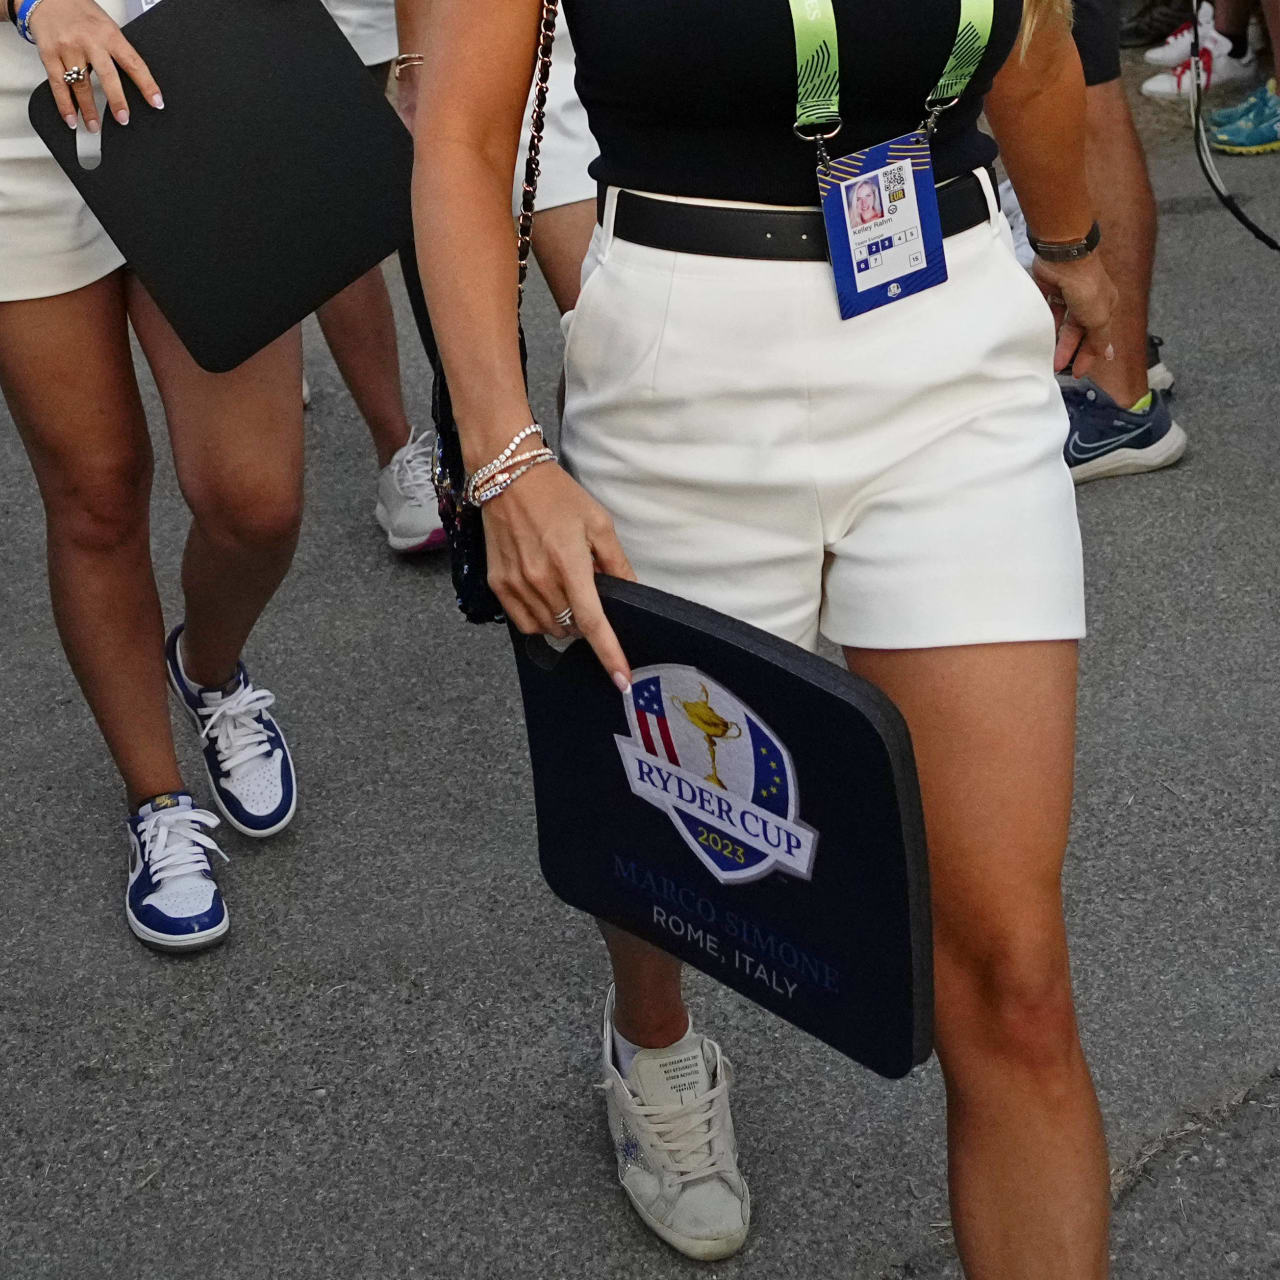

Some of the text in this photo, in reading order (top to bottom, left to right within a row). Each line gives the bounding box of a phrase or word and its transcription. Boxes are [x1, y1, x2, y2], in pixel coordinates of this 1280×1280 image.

[889, 190, 905, 203] EUR
[853, 225, 873, 236] Kelley
[635, 757, 803, 858] RYDER CUP
[697, 826, 746, 865] 2023
[614, 854, 841, 994] MARCO SIMONE
[652, 905, 799, 999] ROME, ITALY
